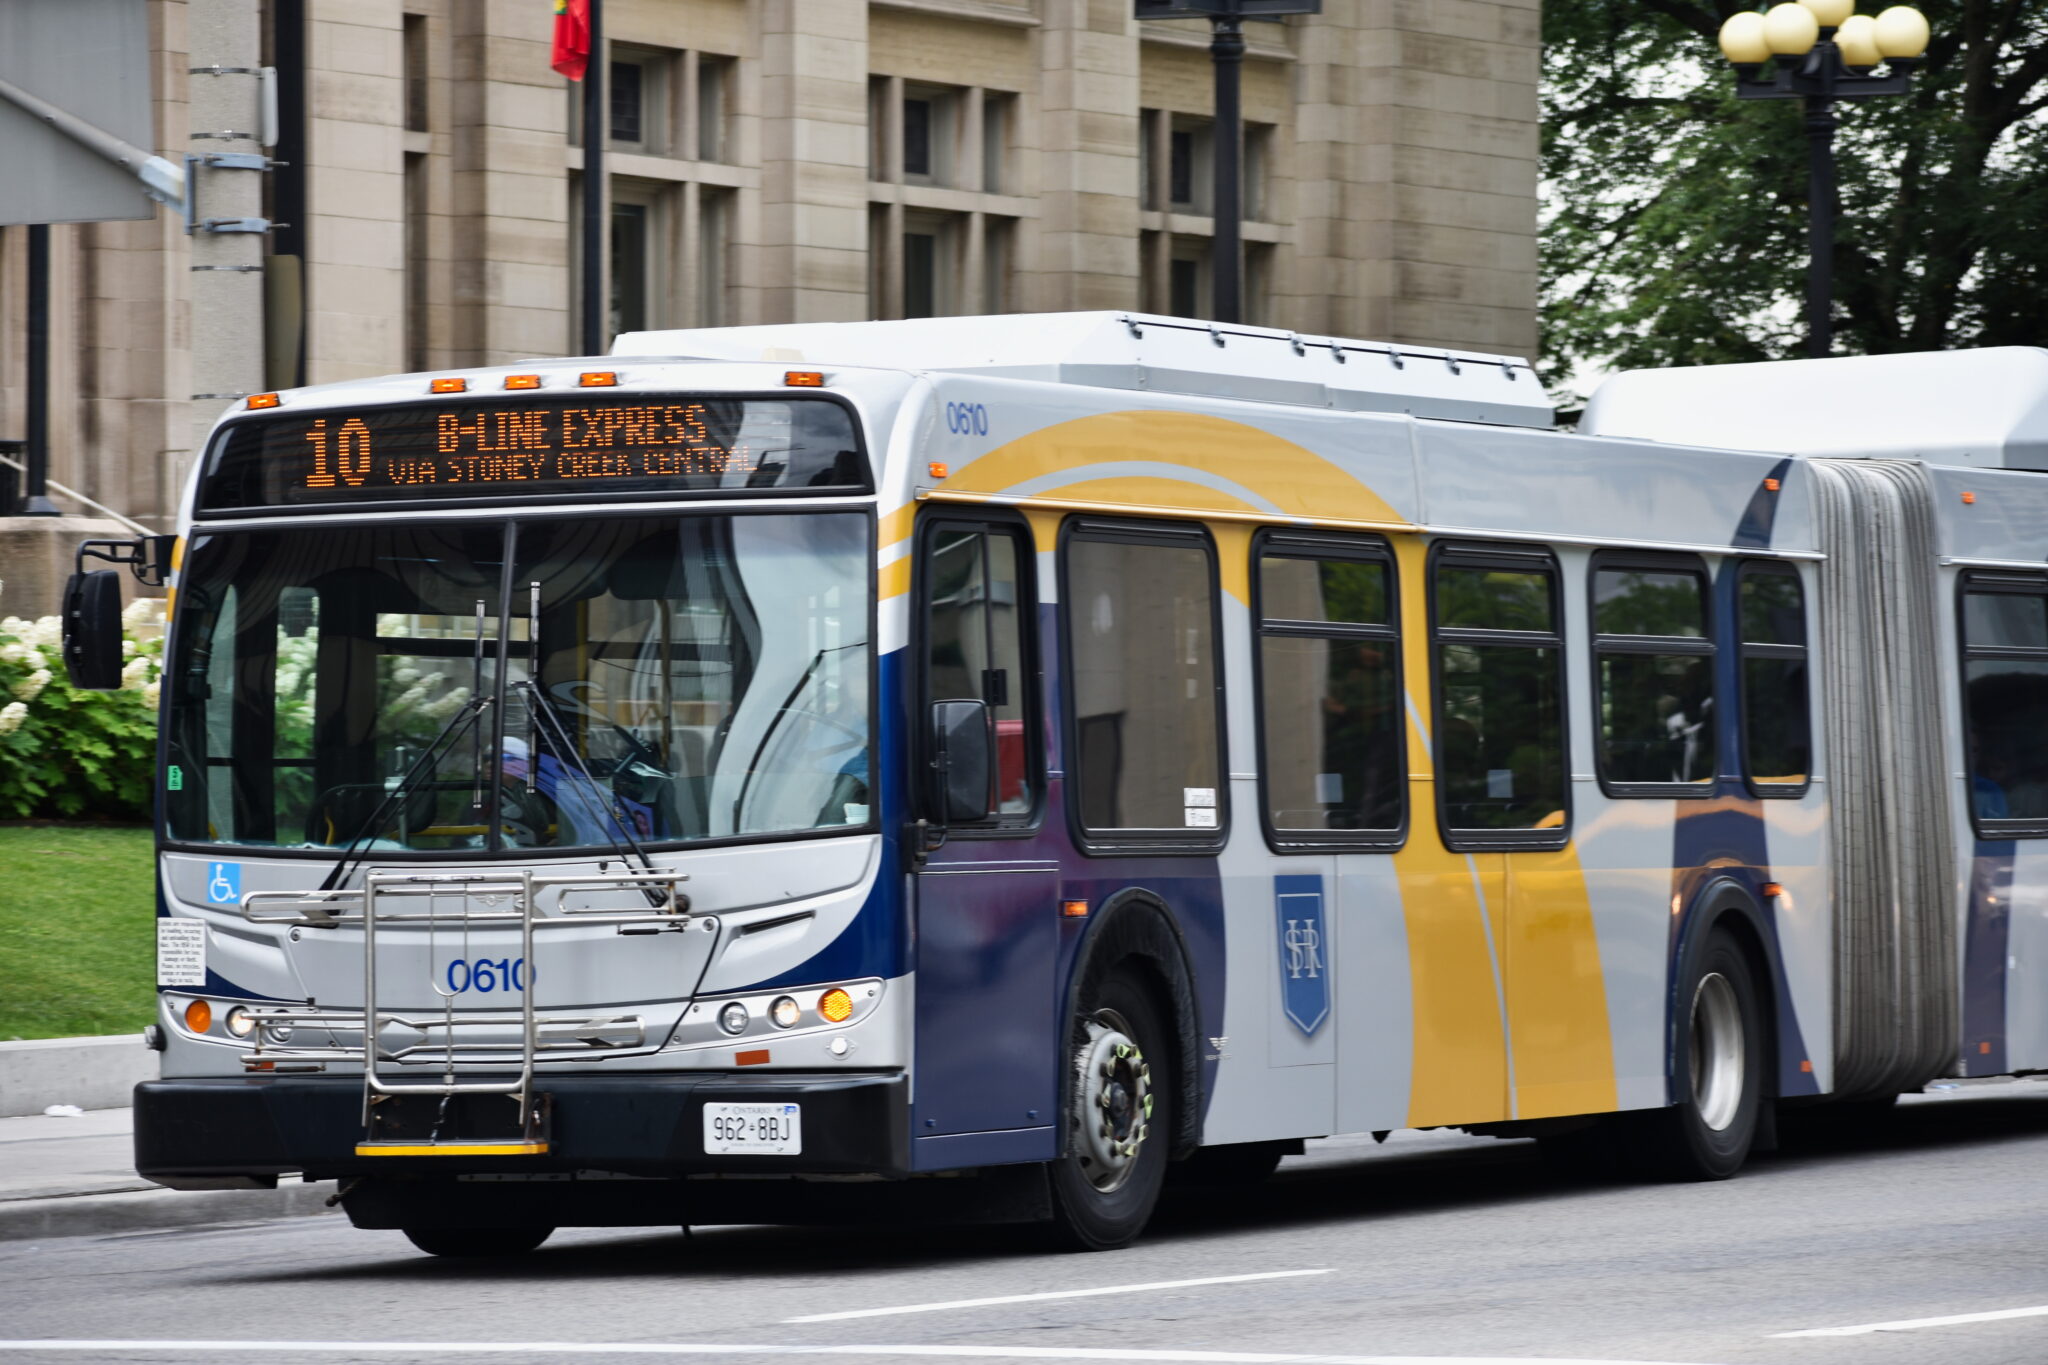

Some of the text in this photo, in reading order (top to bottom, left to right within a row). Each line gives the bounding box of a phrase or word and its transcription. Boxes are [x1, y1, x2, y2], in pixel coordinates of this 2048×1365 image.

[438, 404, 706, 453] B-LINE EXPRESS
[946, 401, 988, 437] 0610
[305, 417, 371, 488] 10
[388, 446, 758, 484] VIA STONEY CREEK CENTRAL
[447, 958, 536, 993] 0610
